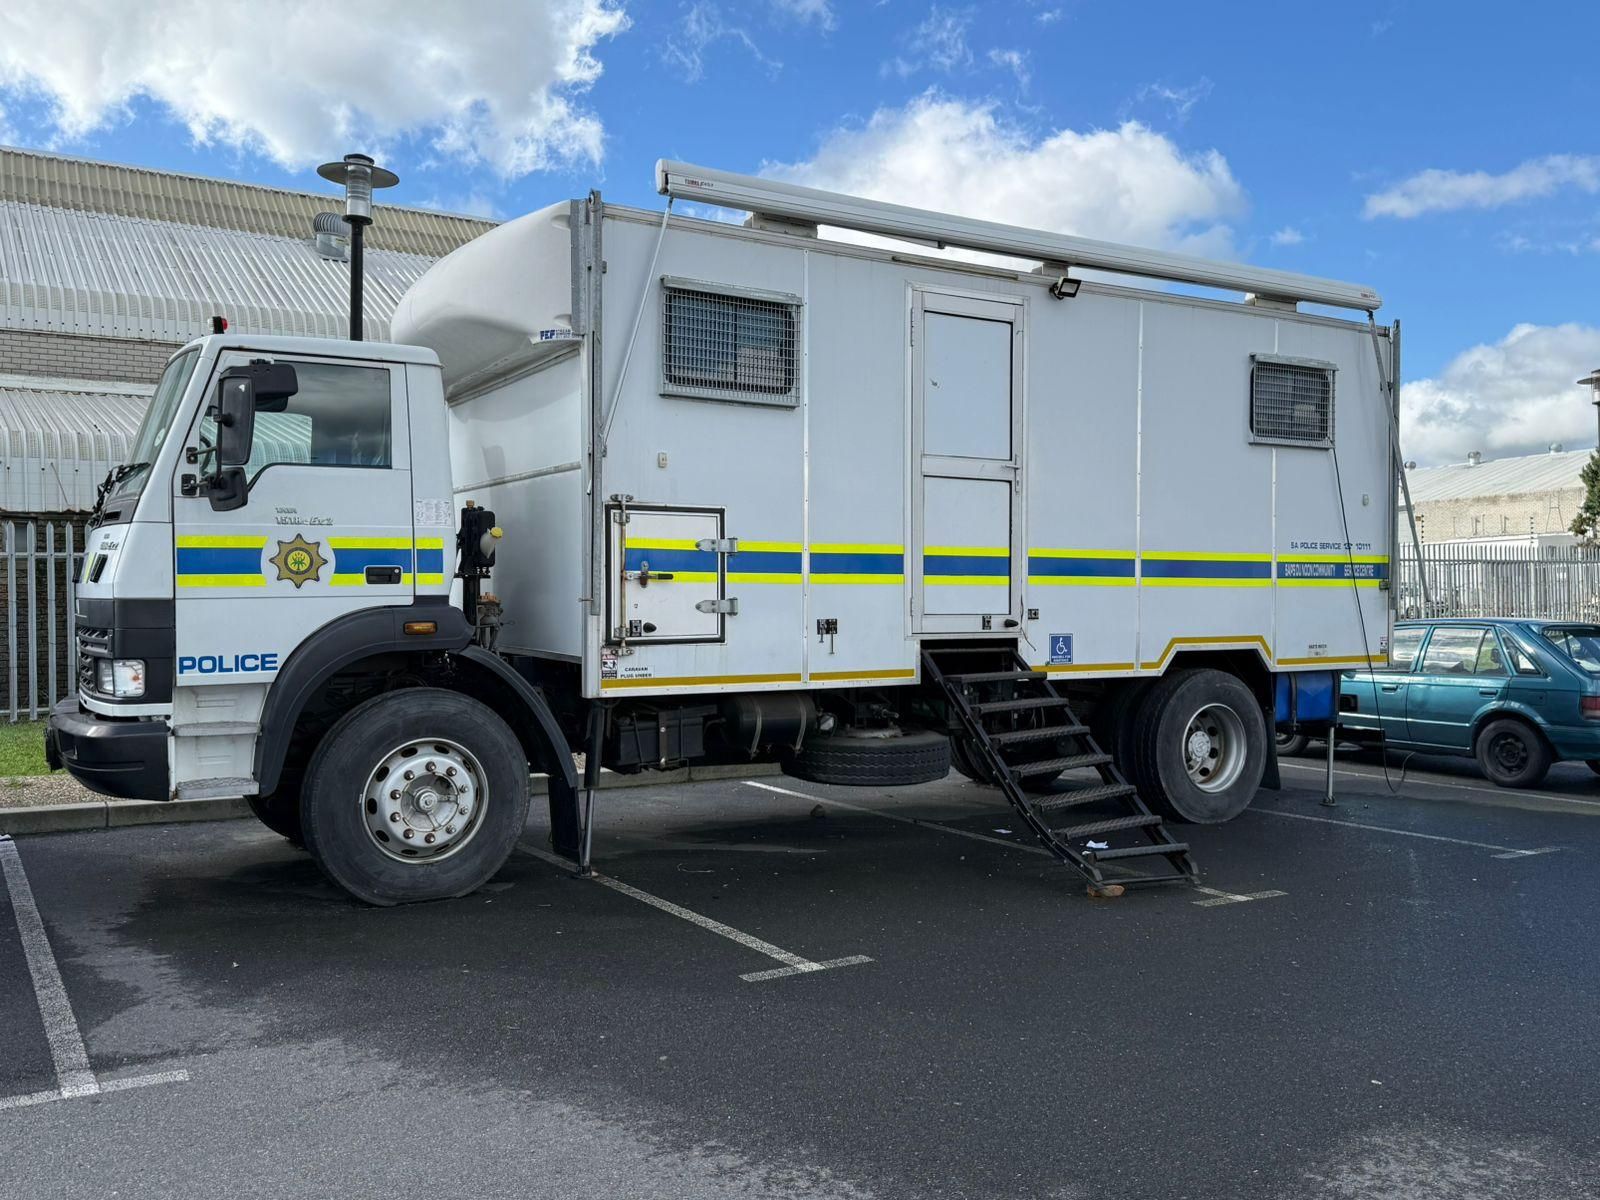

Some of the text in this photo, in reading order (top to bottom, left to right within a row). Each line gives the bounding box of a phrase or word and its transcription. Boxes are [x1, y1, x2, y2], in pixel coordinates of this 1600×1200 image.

[1290, 542, 1371, 551] SA POLICE SERVICE 10111
[178, 653, 279, 675] POLICE
